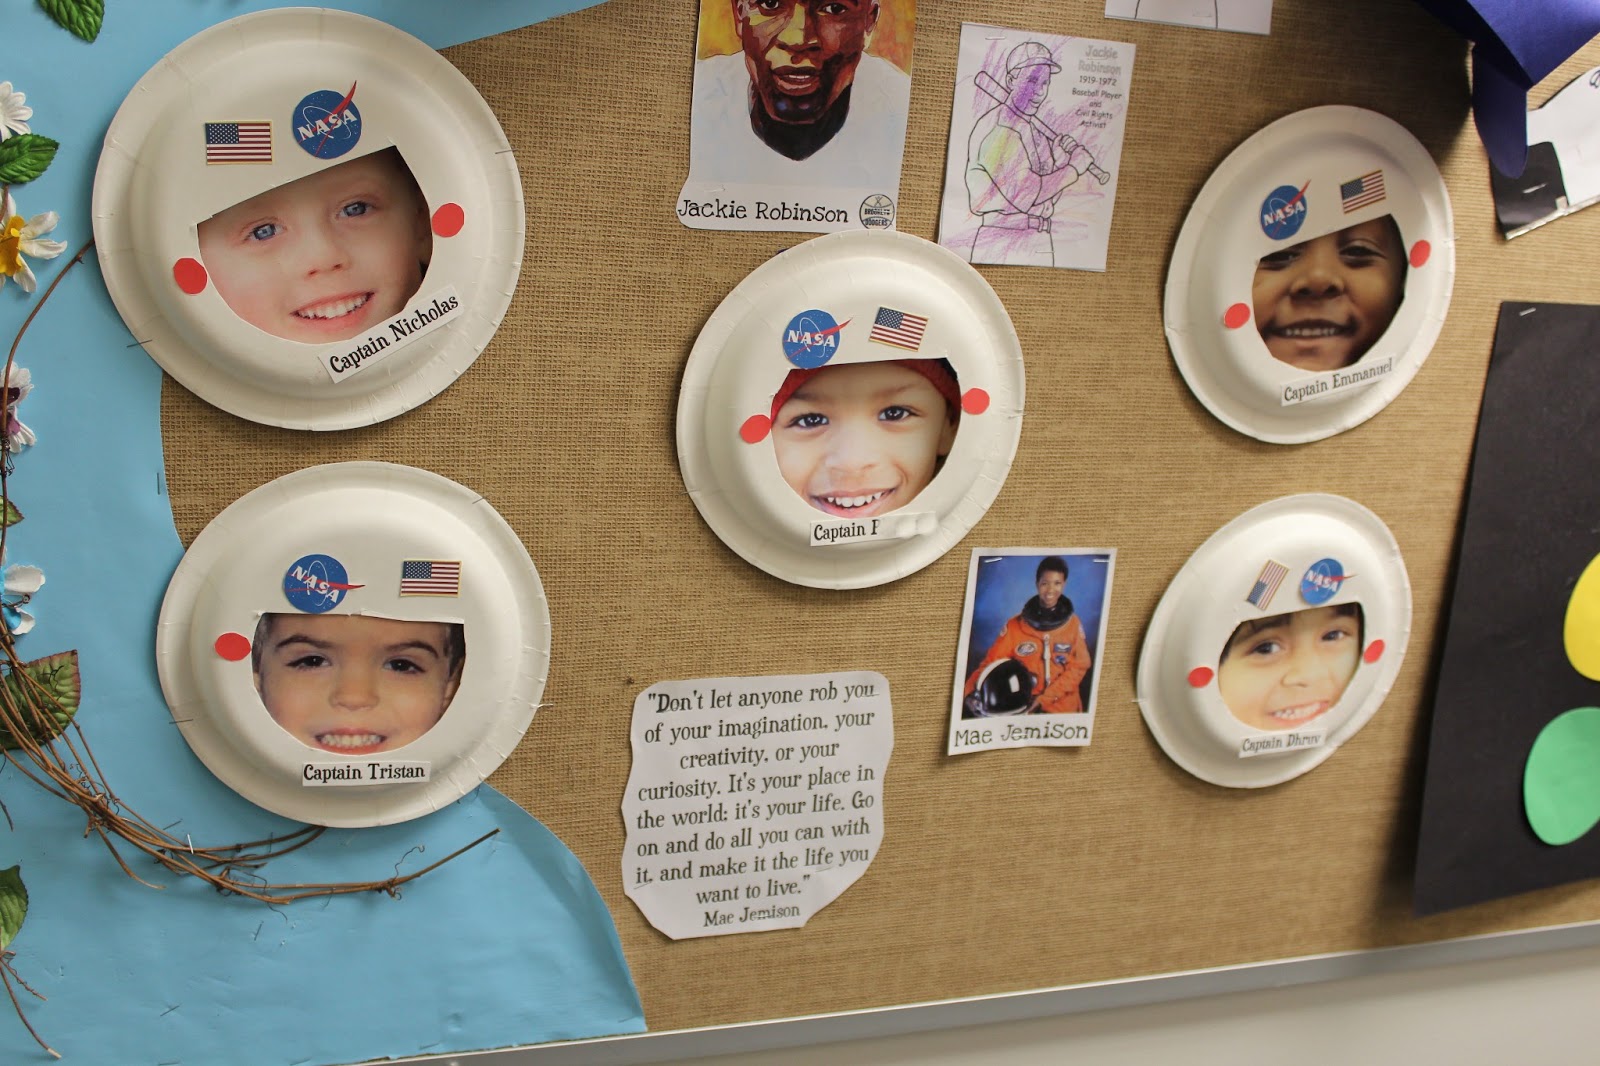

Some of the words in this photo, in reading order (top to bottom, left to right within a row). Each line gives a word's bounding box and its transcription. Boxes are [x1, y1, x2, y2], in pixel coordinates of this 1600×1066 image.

[1085, 45, 1118, 59] Jackie
[1078, 60, 1121, 75] Robinson
[1079, 75, 1117, 86] 1919-1972
[1072, 88, 1099, 97] Baseball
[1100, 90, 1122, 100] Player
[298, 109, 358, 141] NASA
[1075, 109, 1091, 117] Civil
[1091, 110, 1113, 120] Rights
[1080, 120, 1107, 129] Activist
[677, 199, 748, 219] Jackie
[755, 202, 849, 223] Robinson
[1263, 200, 1305, 226] NASA
[329, 335, 391, 375] Captain
[388, 294, 460, 343] Nicholas
[787, 329, 836, 348] NASA
[1284, 380, 1328, 403] Captain
[1332, 357, 1393, 390] Emmanuel
[813, 522, 866, 542] Captain
[291, 565, 340, 603] NASA
[1306, 569, 1340, 593] NASA
[648, 690, 704, 714] "Don't
[710, 689, 733, 709] let
[738, 688, 803, 710] anyone
[809, 681, 838, 701] rob
[844, 683, 875, 703] you
[644, 722, 664, 744] of
[669, 723, 711, 745] your
[834, 711, 875, 732] your
[954, 730, 993, 748] Mae
[1001, 722, 1089, 741] Jemison
[775, 746, 795, 761] or
[799, 742, 840, 764] your
[1242, 737, 1283, 754] Captain
[1286, 733, 1321, 748] Dhruv
[303, 763, 363, 784] Captain
[367, 764, 426, 780] Tristan
[728, 771, 756, 793] It's
[762, 773, 802, 793] your
[807, 766, 851, 790] place
[857, 765, 875, 782] in
[636, 810, 665, 830] the
[734, 799, 761, 821] it's
[766, 800, 807, 821] your
[851, 790, 874, 810] Go
[637, 843, 660, 857] on
[665, 833, 699, 855] and
[704, 831, 725, 851] do
[730, 828, 753, 849] all
[758, 830, 789, 849] you
[794, 826, 825, 842] can
[831, 816, 871, 836] with
[659, 860, 693, 882] and
[699, 857, 748, 879] make
[753, 855, 767, 873] it
[772, 852, 799, 871] the
[804, 846, 834, 868] life
[838, 848, 870, 867] you
[695, 887, 740, 906] want
[745, 884, 762, 900] to
[702, 911, 735, 928] Mae
[739, 903, 801, 923] Jemison
